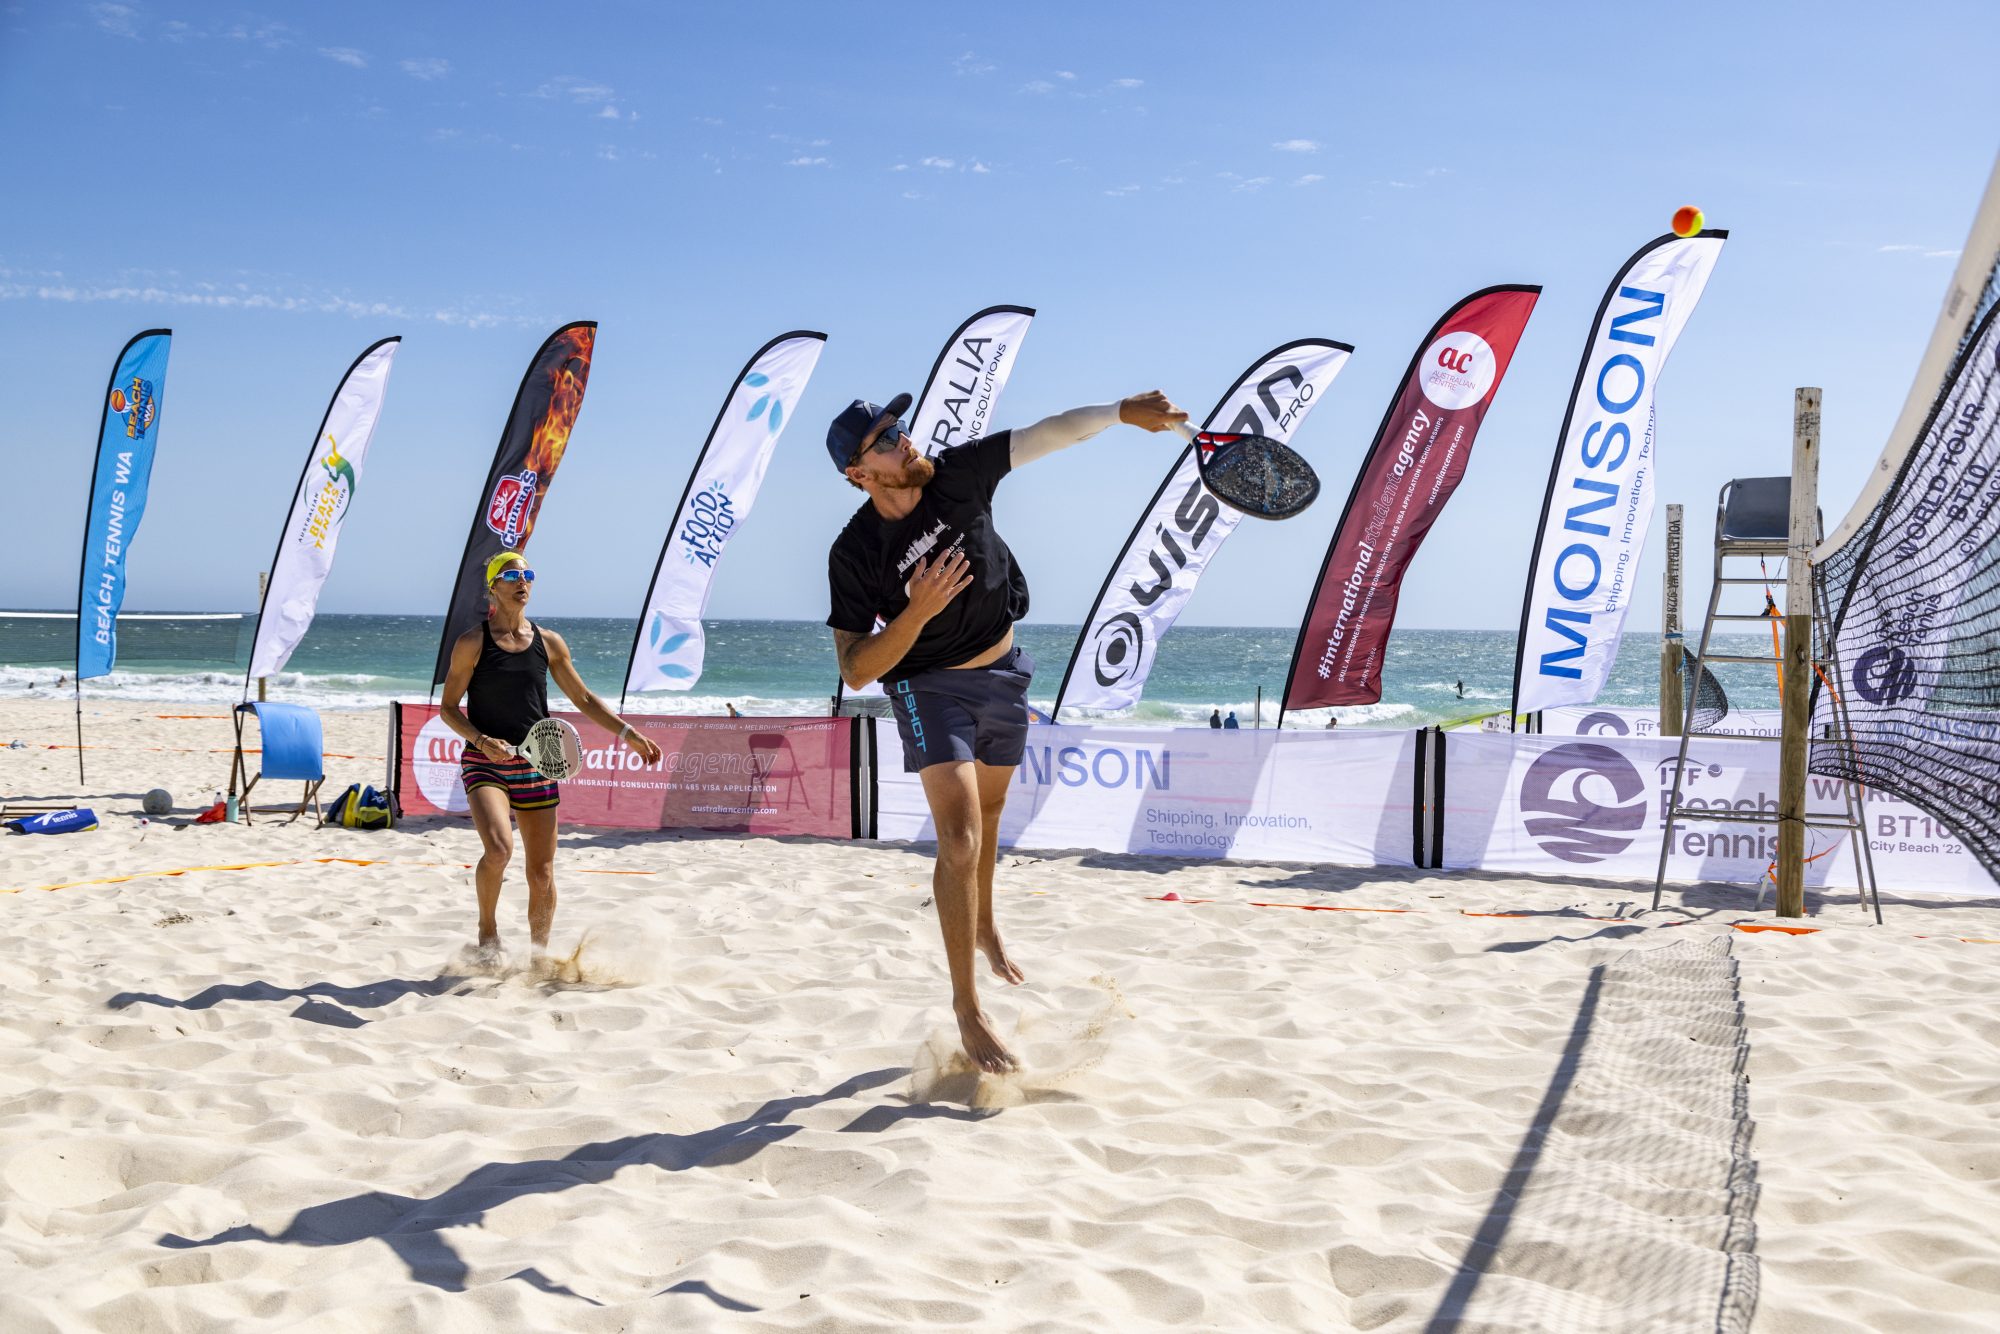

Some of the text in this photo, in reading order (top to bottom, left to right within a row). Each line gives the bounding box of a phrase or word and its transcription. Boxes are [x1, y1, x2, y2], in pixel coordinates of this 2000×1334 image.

[976, 343, 1007, 418] SOLUTIONS
[1429, 376, 1457, 391] CENTRE
[1432, 370, 1476, 390] AUSTRALIAN
[1437, 347, 1473, 374] ac
[127, 377, 142, 438] BEACH
[144, 403, 153, 422] WA
[924, 338, 992, 460] RALIA
[1279, 383, 1314, 433] PRO
[1428, 425, 1465, 505] australiancentre.com
[1539, 286, 1665, 679] MONSON
[1894, 403, 1985, 560] WORLD TOUR
[298, 493, 319, 543] AUSTRALIAN
[309, 481, 333, 537] BEACH
[336, 488, 347, 509] TOUR
[500, 469, 537, 548] CHURRAS
[1946, 464, 1988, 522] BT10
[314, 489, 339, 550] TENNIS
[681, 491, 717, 549] FOOD
[695, 492, 735, 568] ACTION
[1345, 625, 1361, 666] ASSESSMENT
[1359, 587, 1375, 619] MIGRATION
[1372, 542, 1393, 587] CONSULTATION
[1396, 510, 1406, 525] VISA
[1402, 469, 1422, 510] APPLICATION
[1420, 416, 1444, 465] SCHOLARSHIPS
[1605, 549, 1630, 613] Shipping,
[1622, 467, 1647, 543] Innovation,
[95, 452, 133, 645] BEACH TENNIS WA
[1892, 592, 1924, 643] Beach
[1907, 595, 1941, 646] Tennis
[428, 737, 462, 765] ac
[645, 721, 666, 729] PERTH
[672, 722, 698, 730] SYDNEY
[703, 723, 738, 731] BRISBANE
[1636, 723, 1655, 731] ITF
[578, 779, 619, 787] MIGRATION
[621, 780, 678, 790] CONSULTATION
[702, 784, 721, 792] VISA
[723, 784, 778, 793] APPLICATION
[1019, 745, 1170, 791] NSON
[52, 812, 78, 823] tennis
[691, 804, 778, 815] australiancentre.com
[1146, 807, 1313, 831] Shipping, Innovation,
[1149, 828, 1240, 850] Technology.
[1870, 840, 1896, 853] City
[1899, 841, 1939, 854] Beach
